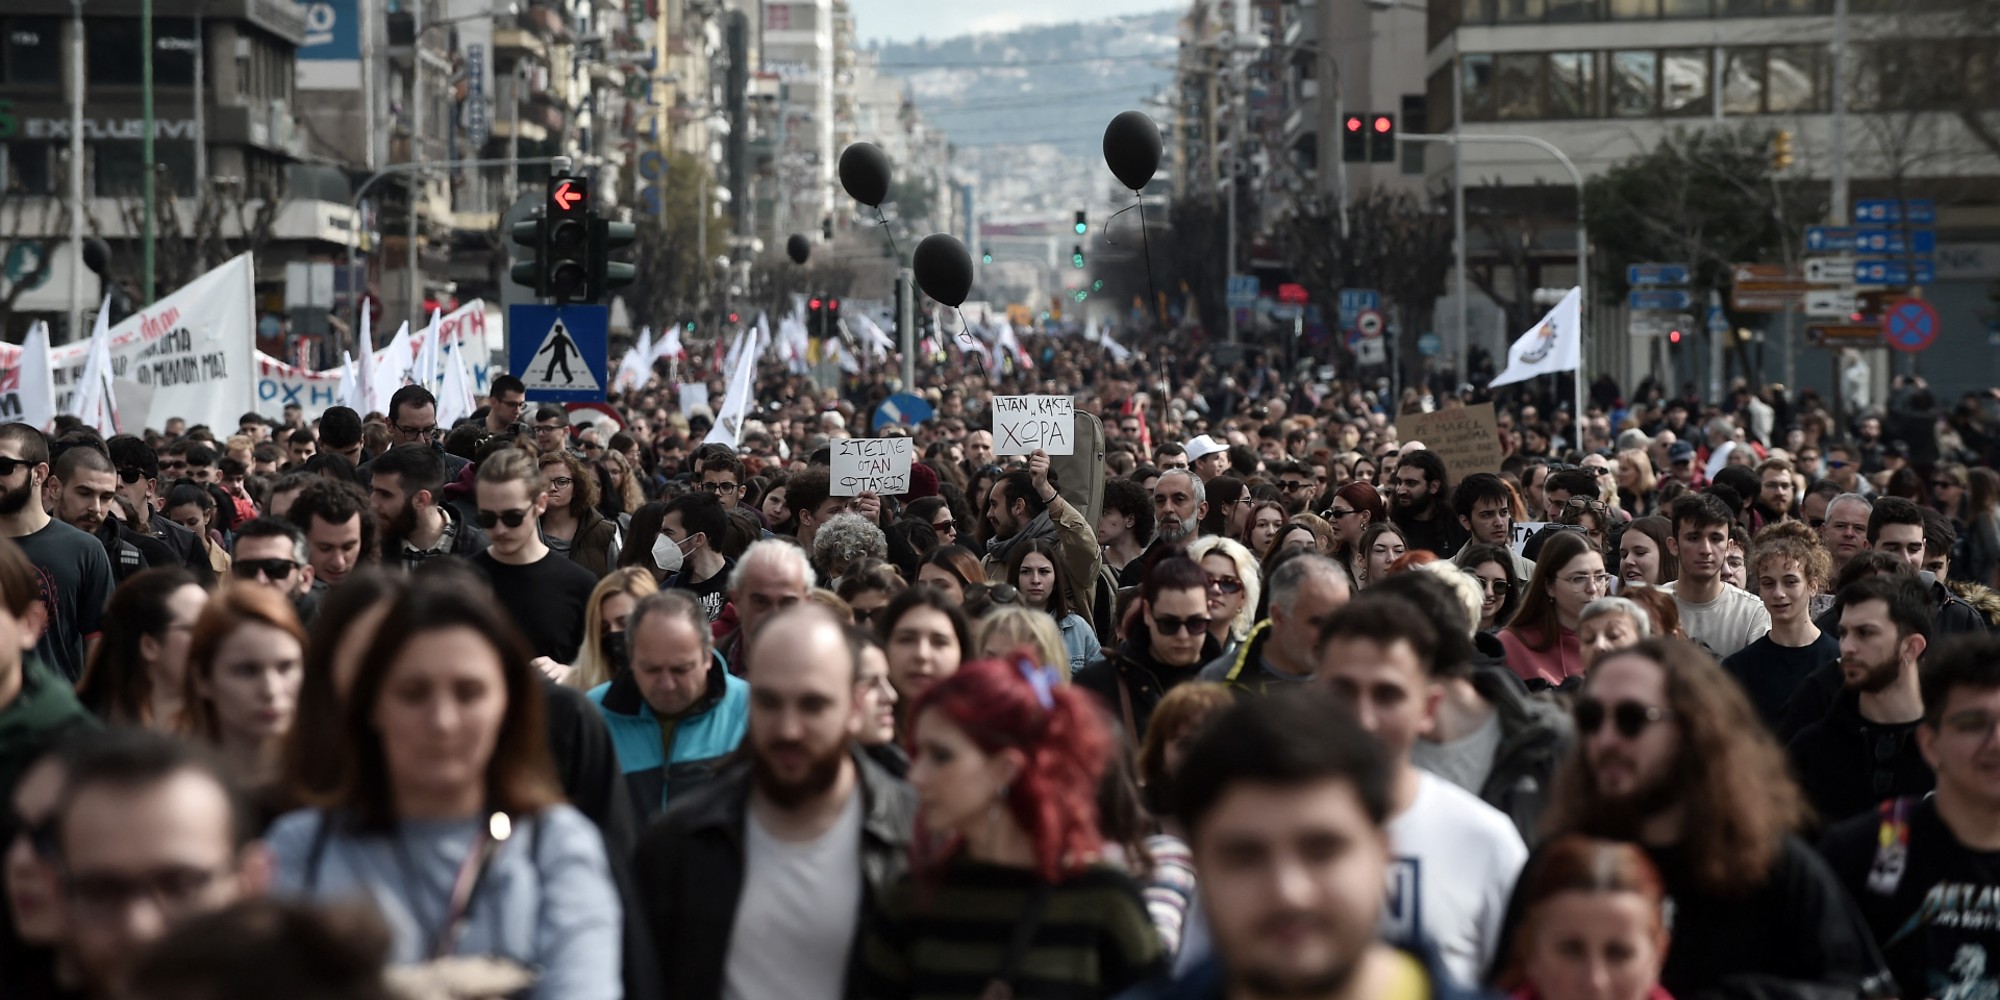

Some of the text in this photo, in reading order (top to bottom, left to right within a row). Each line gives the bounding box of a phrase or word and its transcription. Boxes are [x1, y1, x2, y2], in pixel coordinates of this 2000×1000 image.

[996, 398, 1028, 413] ΗΤΑΝ
[1038, 398, 1072, 416] ΚΑΚΙΑ
[1001, 420, 1065, 449] ΧΩΡΑ
[839, 439, 904, 456] ΣΤΕΙΛΕ
[858, 458, 891, 475] ΟΤΑΝ
[840, 474, 905, 495] ΦΤΑΣΕΙΣ
